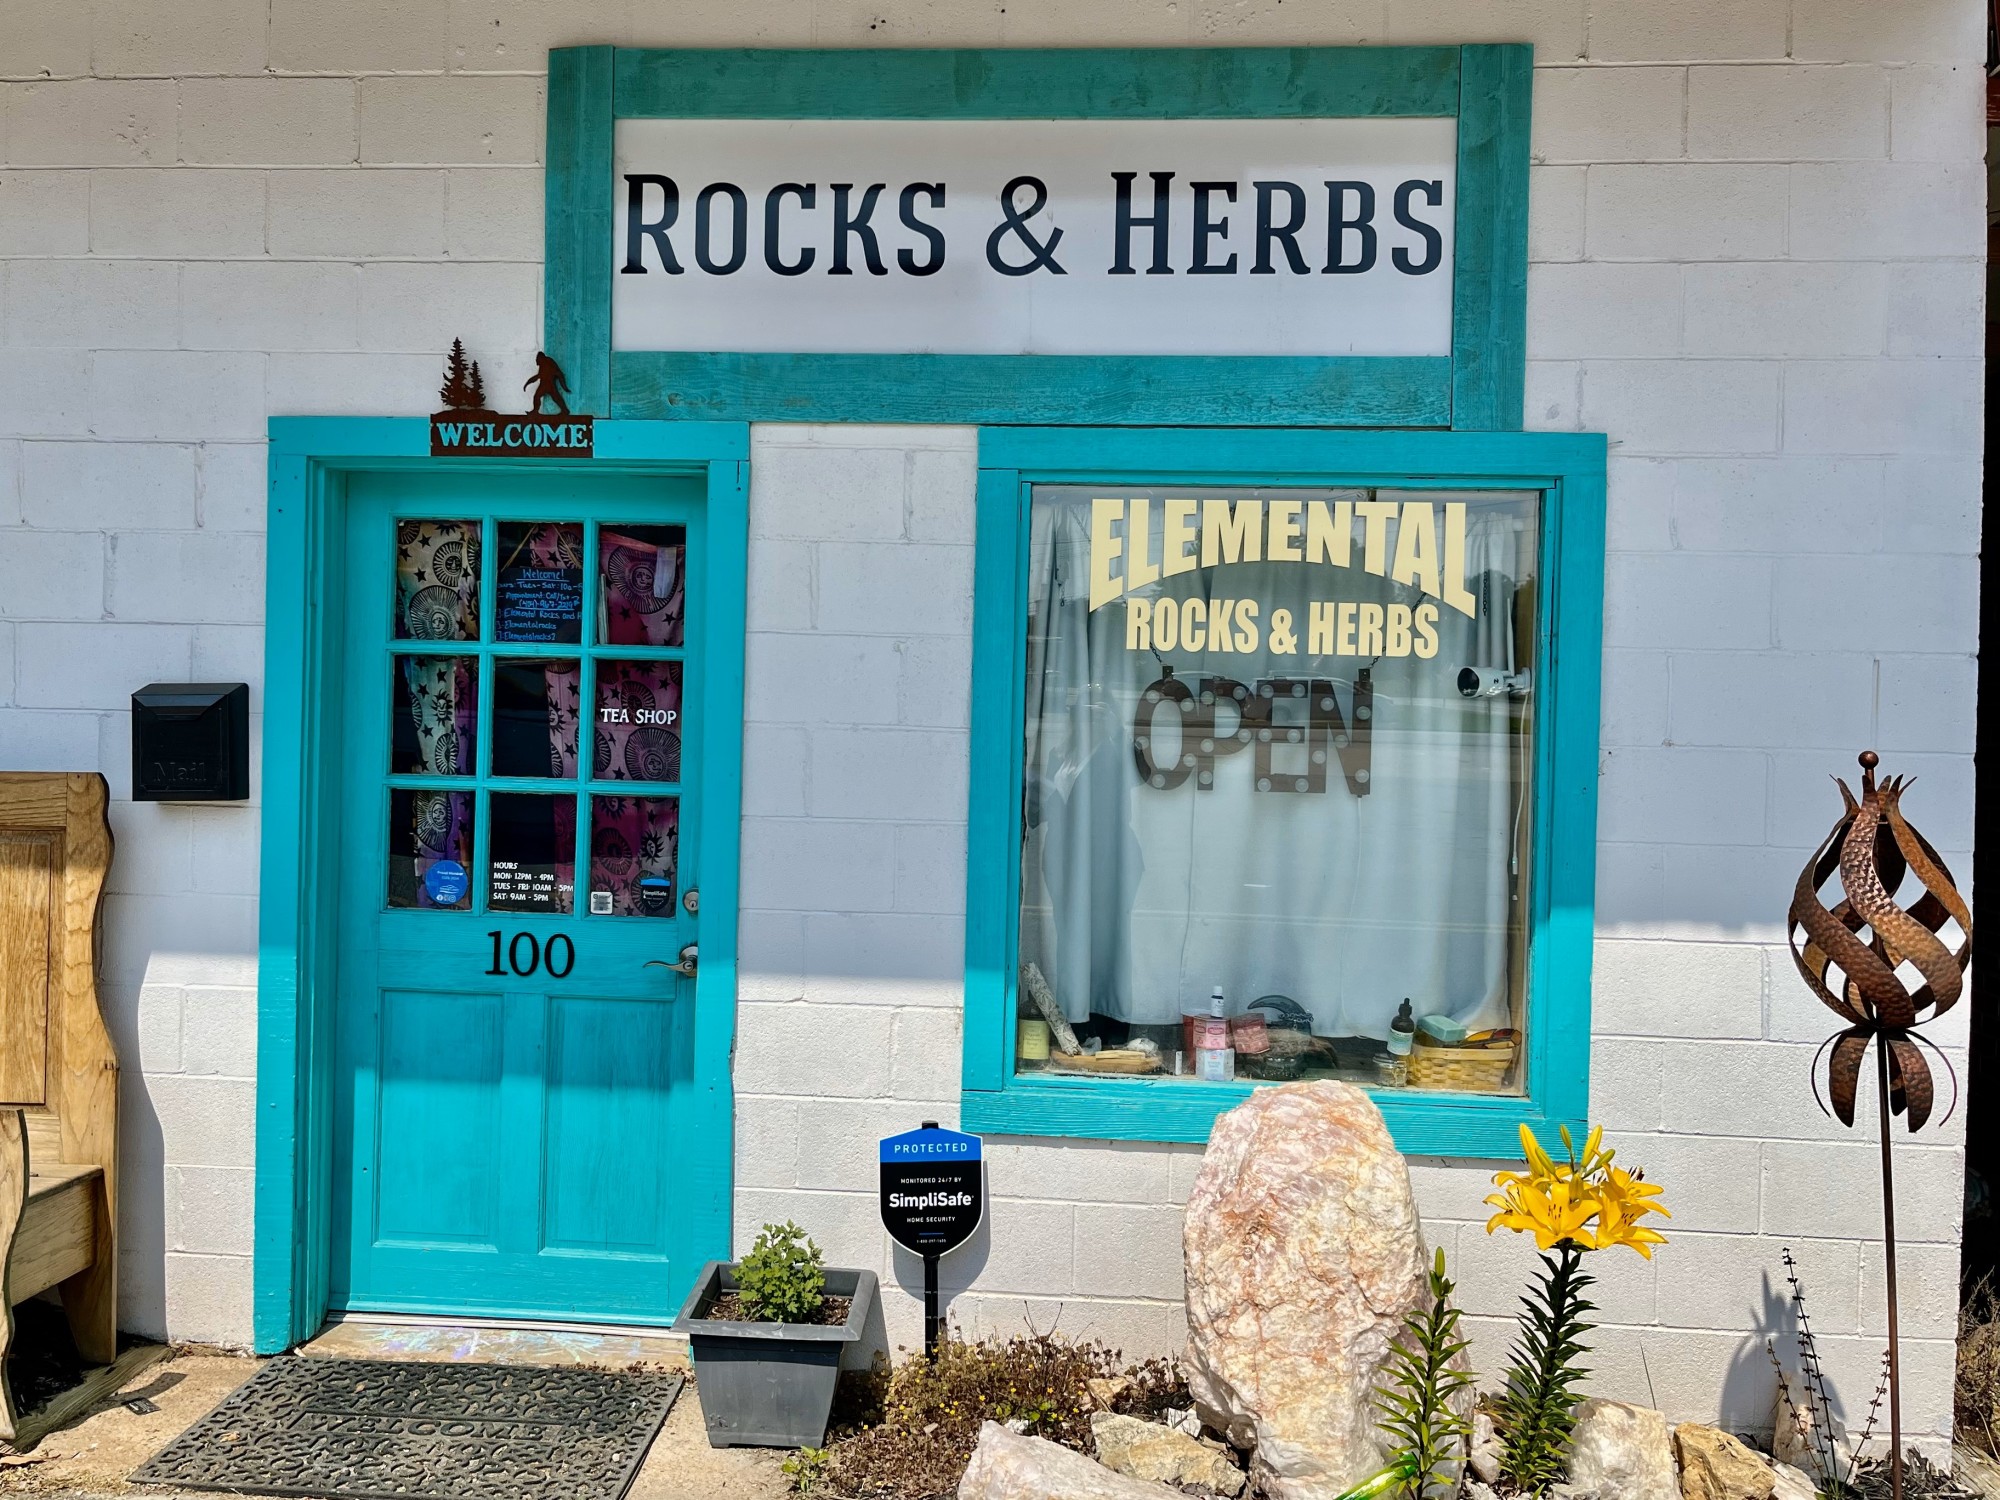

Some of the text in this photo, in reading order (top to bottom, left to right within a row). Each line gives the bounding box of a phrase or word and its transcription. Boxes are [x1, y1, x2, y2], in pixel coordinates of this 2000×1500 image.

[620, 171, 1443, 276] ROCKS & HERBS
[436, 422, 588, 448] WELCOME
[1089, 498, 1476, 620] ELEMENTAL
[522, 568, 565, 580] Welcome!
[1126, 597, 1439, 659] ROCKS & HERBS
[600, 708, 677, 725] TEA SHOP
[1133, 676, 1374, 796] OPEN
[493, 861, 518, 870] HOURS
[493, 882, 510, 890] TUES
[517, 883, 530, 891] FRI:
[532, 883, 551, 891] 10AM
[539, 873, 554, 881] 4PM
[493, 892, 508, 900] SAT:
[510, 892, 526, 900] 9AM
[533, 893, 549, 901] 5PM
[485, 930, 575, 978] 100
[894, 1142, 968, 1154] PROTECTED
[889, 1191, 973, 1210] SimpliSafe
[310, 1413, 547, 1441] WELCOME
